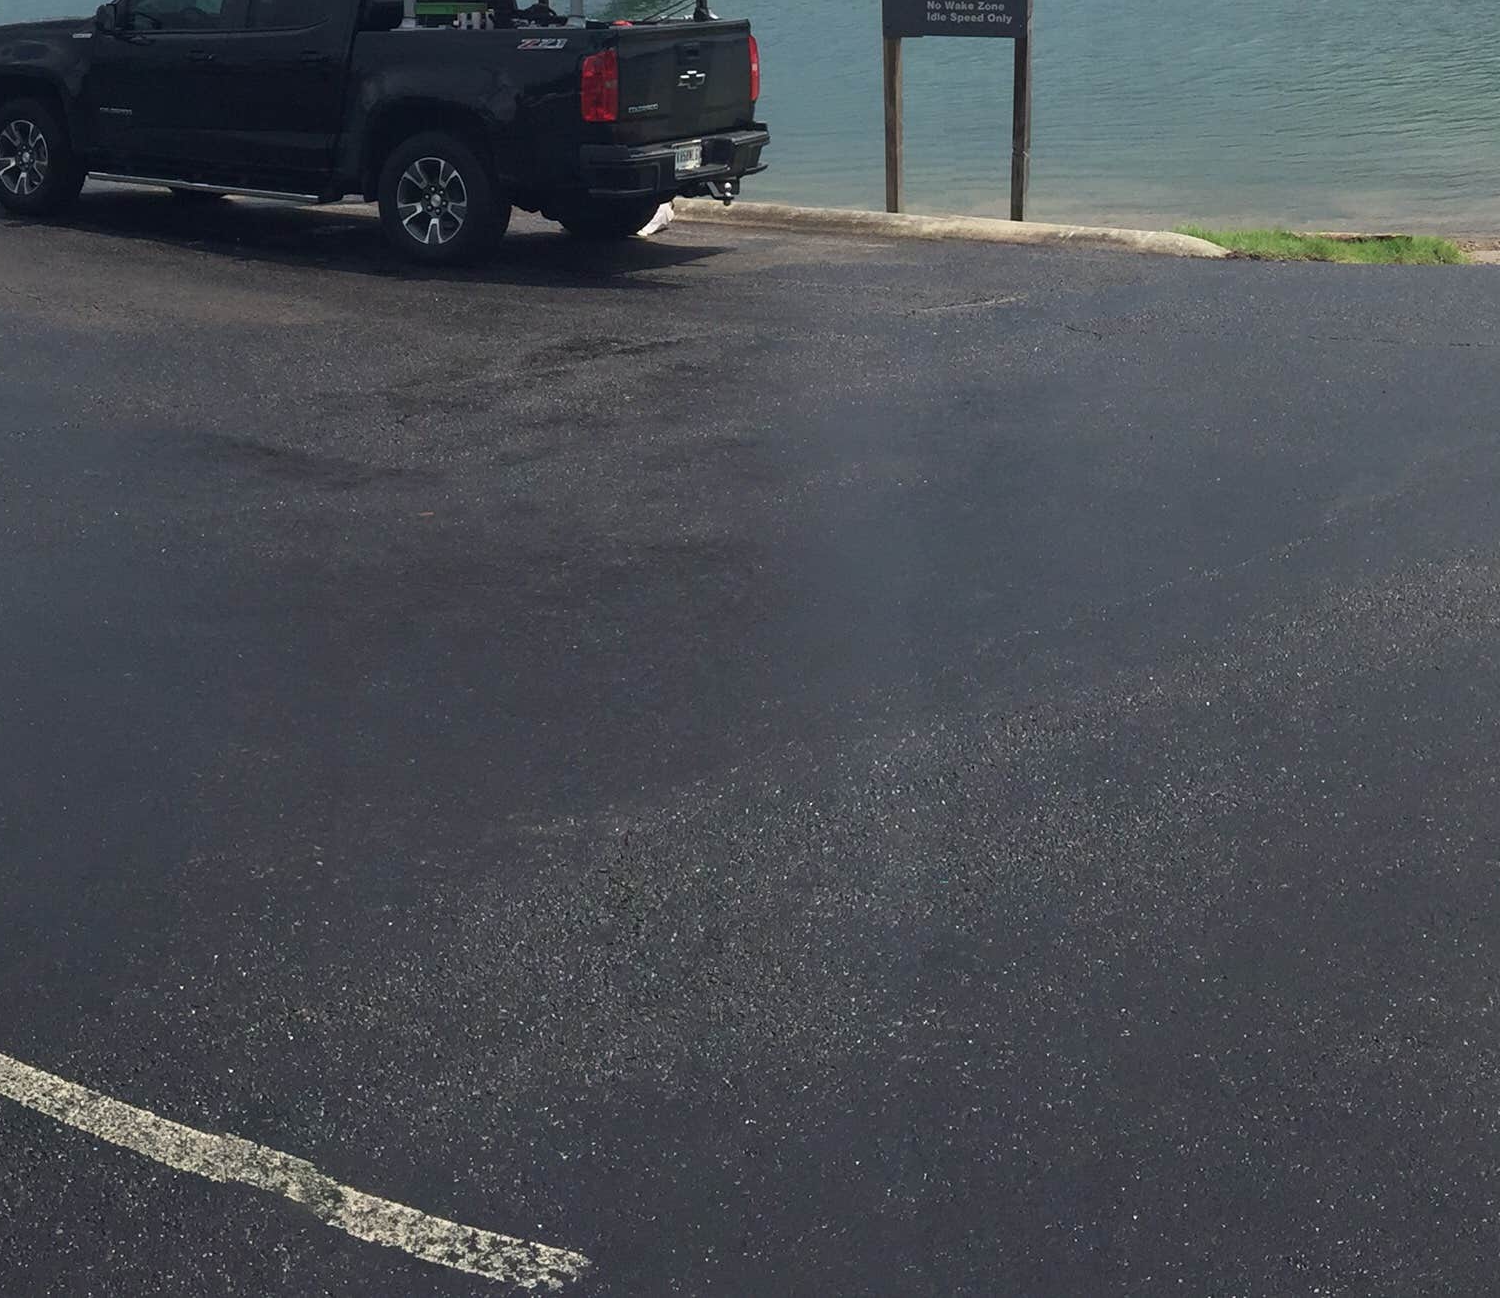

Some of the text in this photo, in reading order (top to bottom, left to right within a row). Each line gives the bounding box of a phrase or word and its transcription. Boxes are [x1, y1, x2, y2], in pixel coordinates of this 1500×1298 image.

[927, 1, 1005, 11] No Wake Zone
[927, 13, 1013, 24] Idle Speed Only
